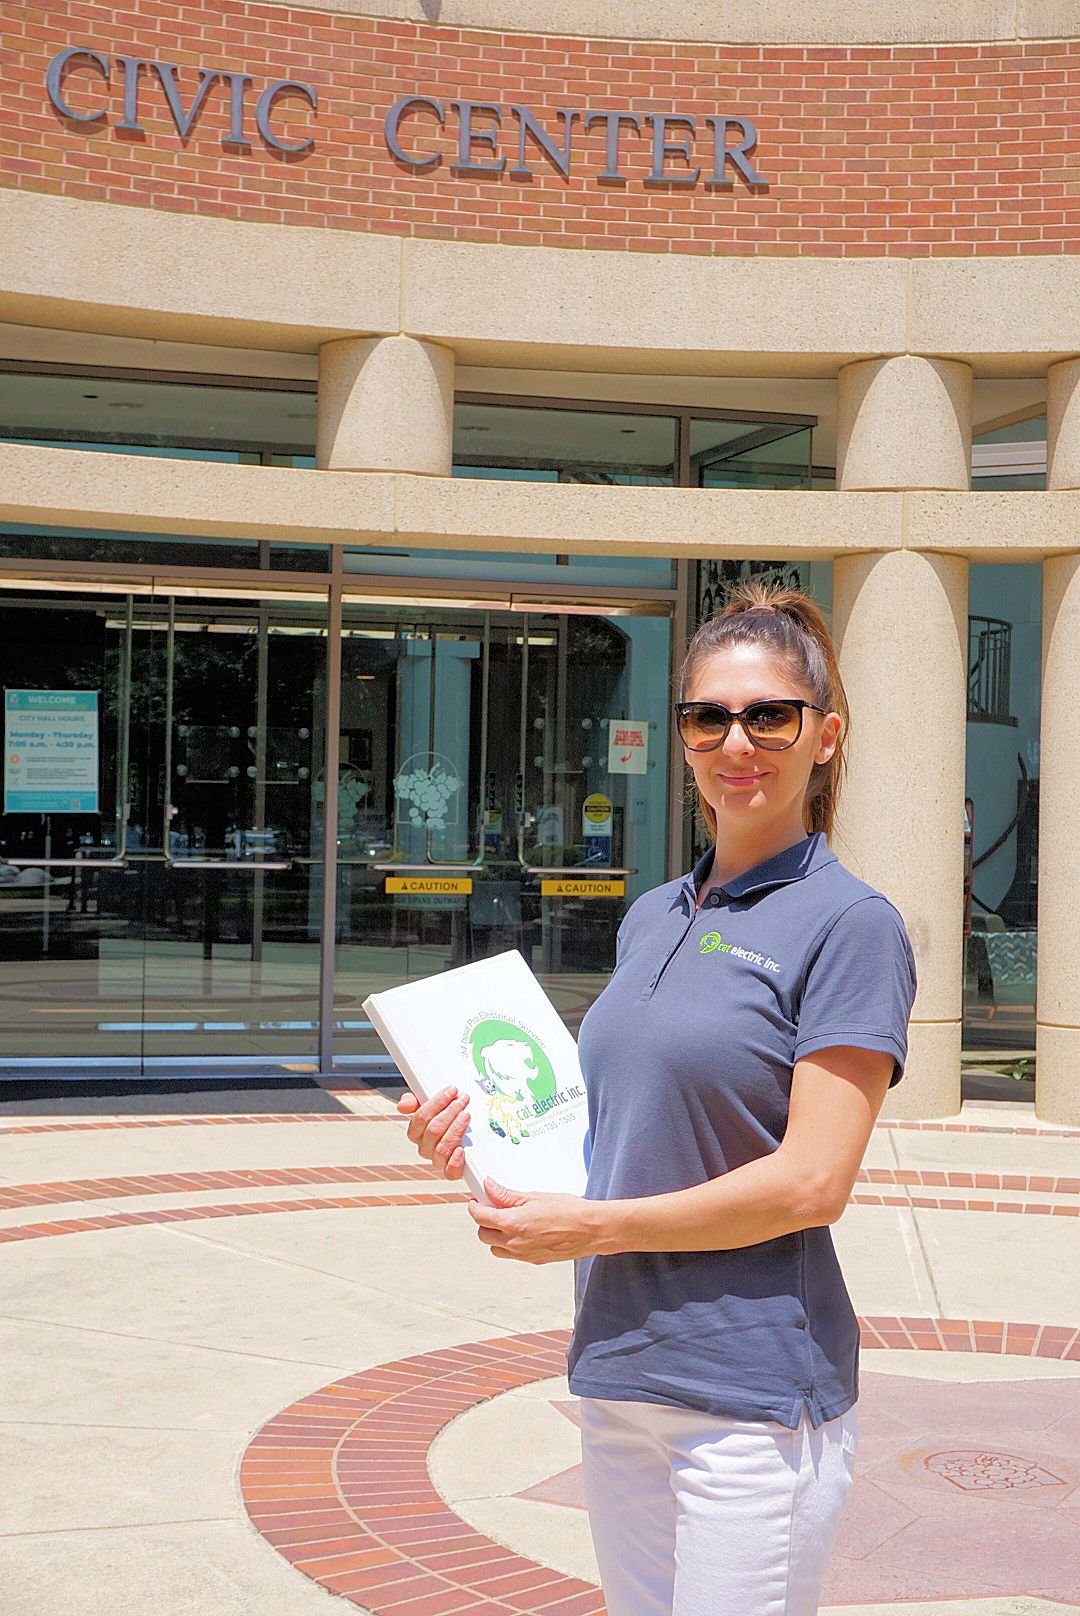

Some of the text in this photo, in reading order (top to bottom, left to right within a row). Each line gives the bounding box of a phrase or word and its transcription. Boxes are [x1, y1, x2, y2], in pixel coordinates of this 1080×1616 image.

[47, 47, 768, 187] CIVIC CENTER
[28, 695, 76, 704] WELCOME
[19, 714, 35, 722] CITY
[58, 715, 85, 723] HOURS
[10, 731, 45, 739] Monday
[52, 731, 93, 740] Thursday
[410, 881, 458, 891] CAUTION
[565, 884, 611, 893] CAUTION
[717, 943, 781, 973] cat electric inc.
[467, 1016, 480, 1027] Pro
[516, 1104, 534, 1121] cat
[532, 1091, 569, 1115] electric
[564, 1085, 586, 1100] inc.
